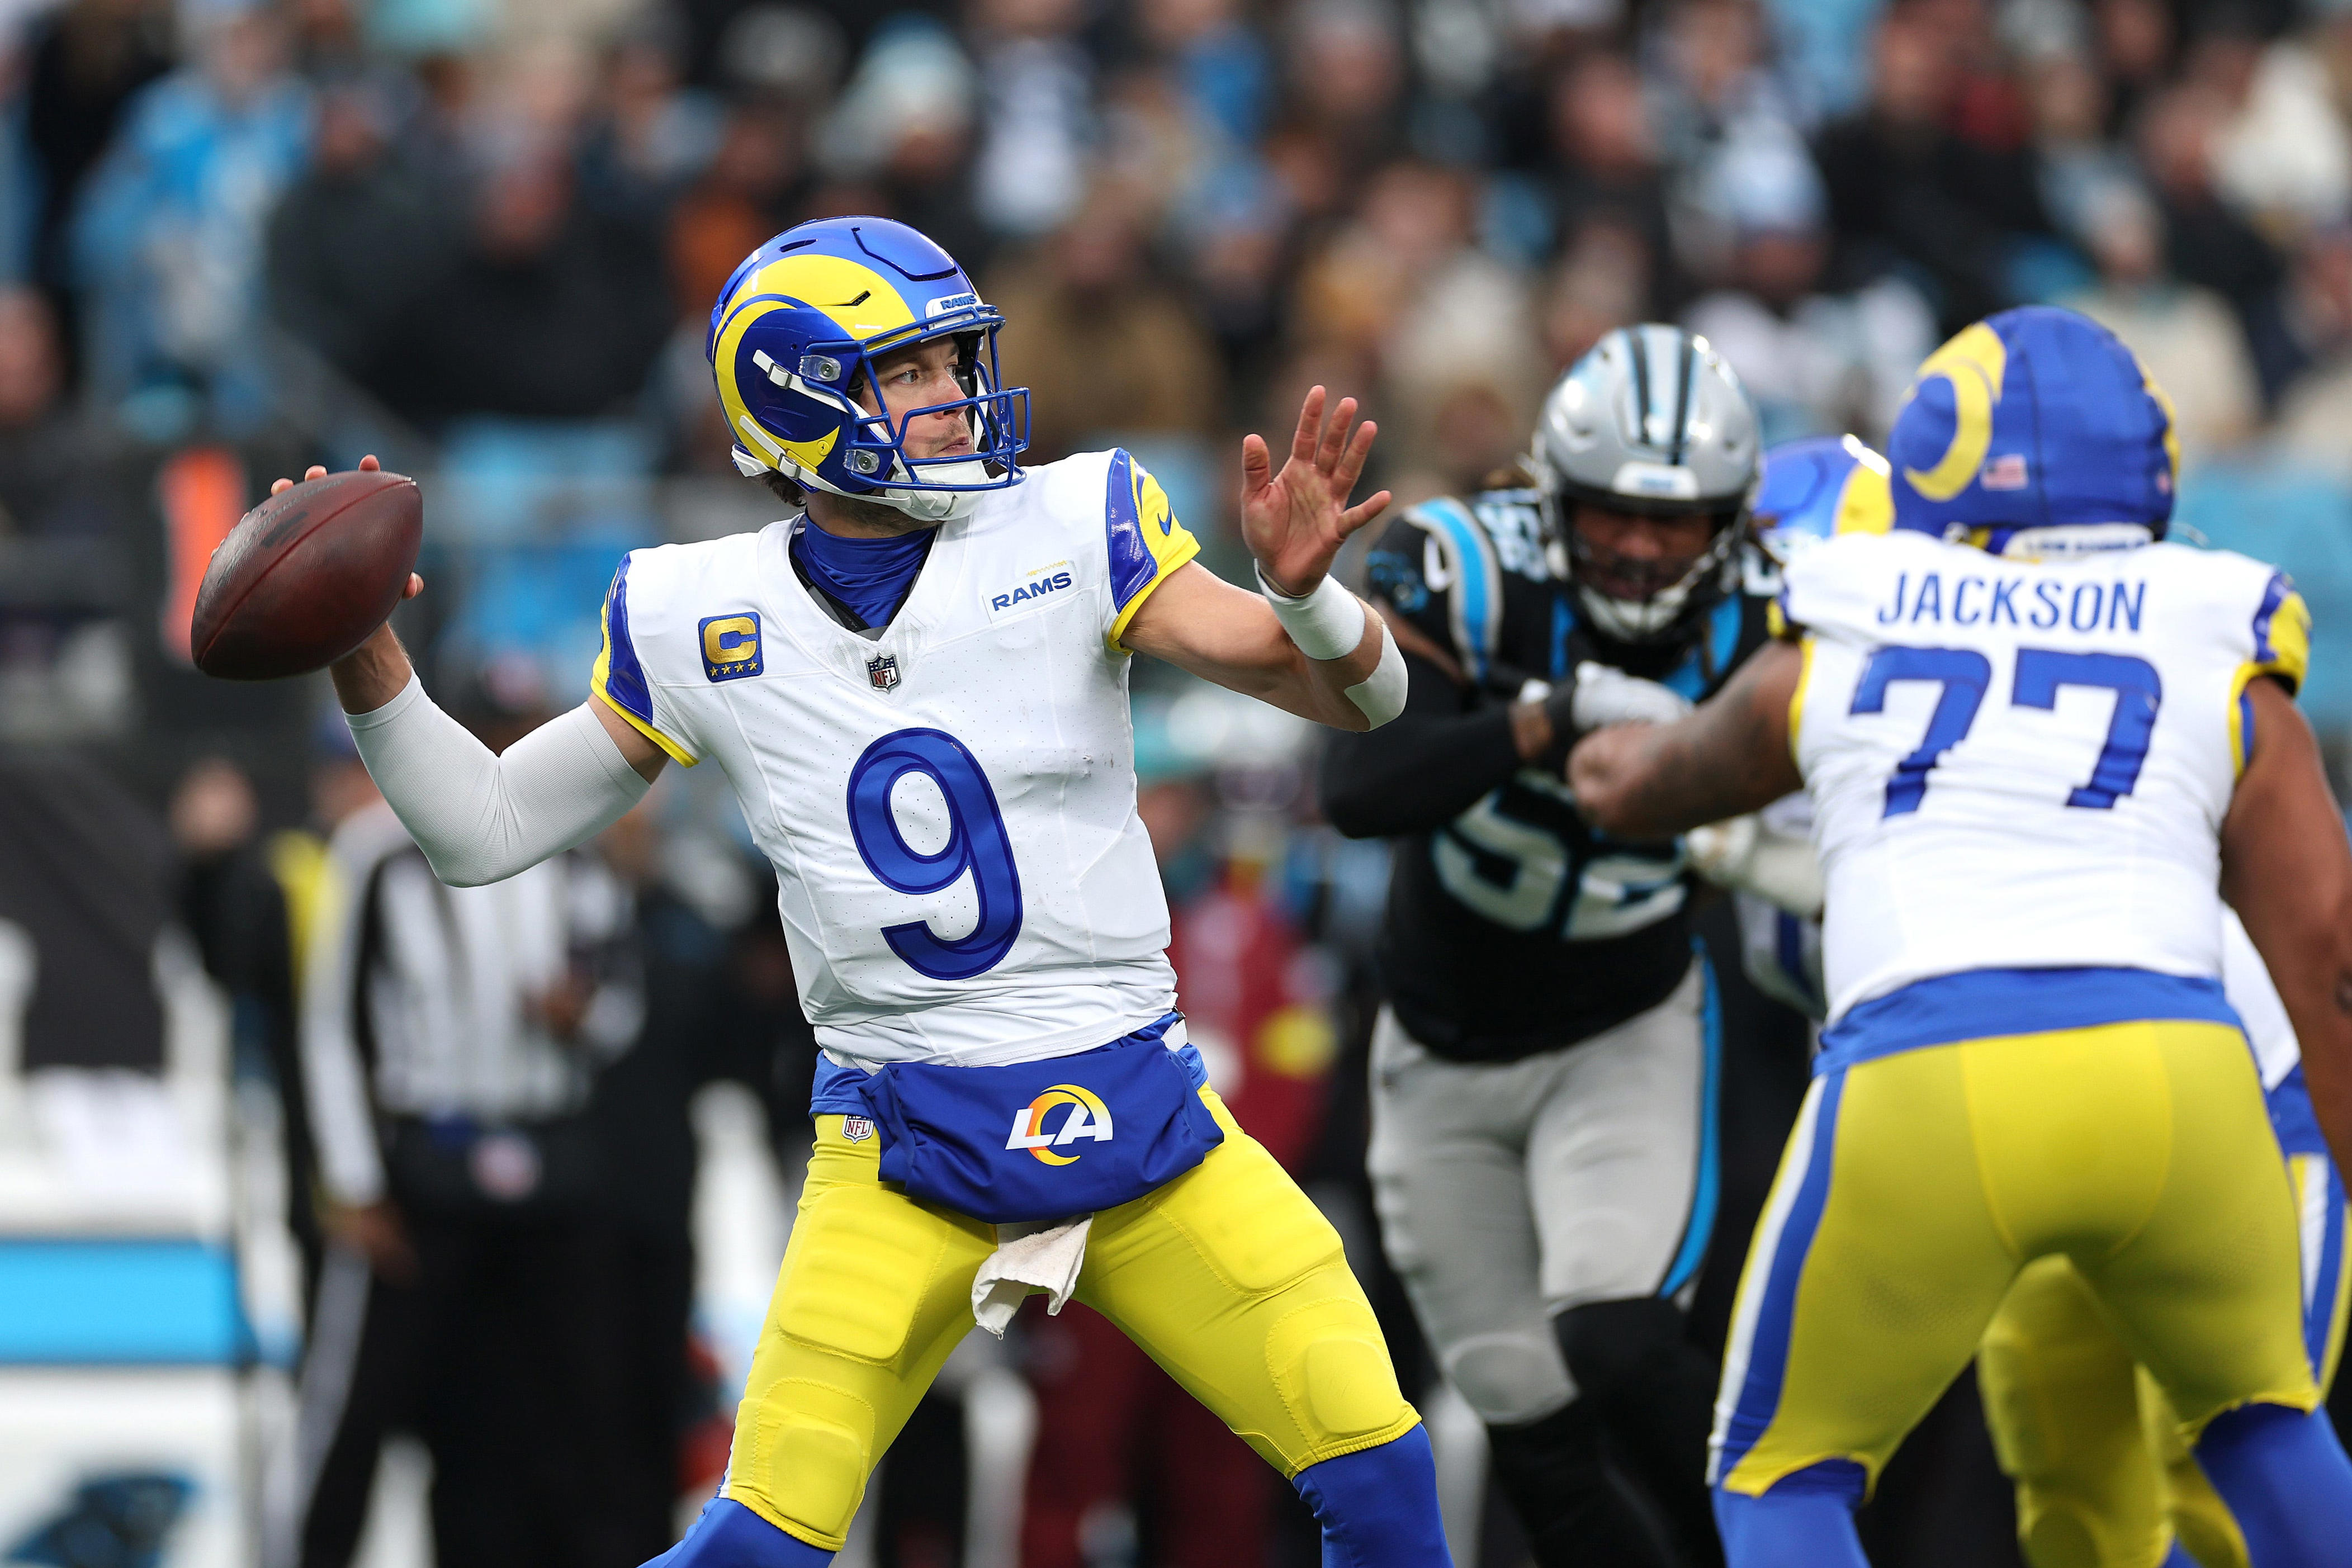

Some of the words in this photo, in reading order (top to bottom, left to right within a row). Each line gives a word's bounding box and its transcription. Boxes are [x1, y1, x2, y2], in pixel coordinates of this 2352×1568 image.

[940, 295, 977, 310] RAMS
[991, 572, 1072, 612] RAMS
[1878, 574, 2146, 632] JACKSON
[704, 617, 757, 664] C
[873, 669, 896, 686] NFL
[1849, 646, 2162, 819] 77
[846, 727, 1023, 980] 9
[846, 1121, 867, 1135] NFL
[1005, 1083, 1114, 1158] LA
